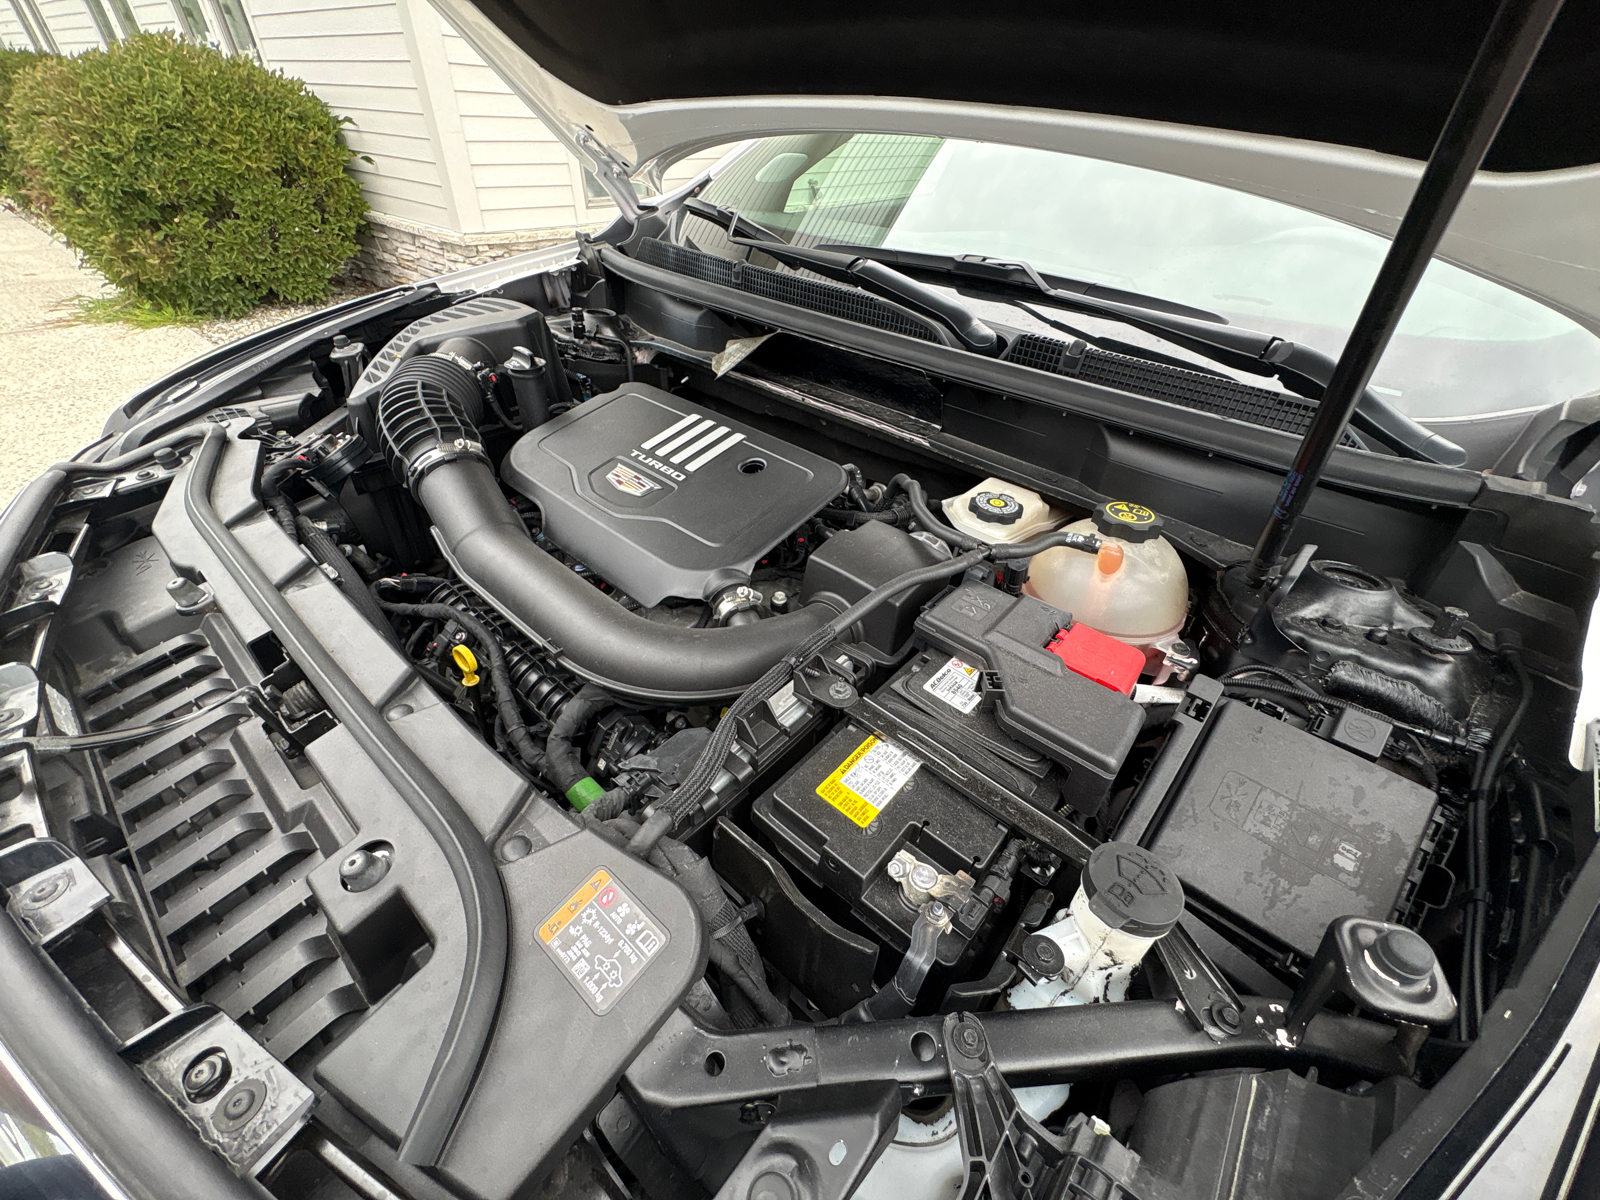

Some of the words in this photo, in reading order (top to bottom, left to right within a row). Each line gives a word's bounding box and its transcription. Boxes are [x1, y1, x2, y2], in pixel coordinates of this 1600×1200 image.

[630, 449, 687, 482] TURBO
[610, 911, 622, 924] AUTO
[580, 934, 592, 948] PAG
[593, 920, 615, 945] R-1234yf
[618, 939, 633, 956] 0.700
[629, 952, 638, 964] kg
[583, 976, 599, 994] 1.000
[594, 990, 604, 1003] kg
